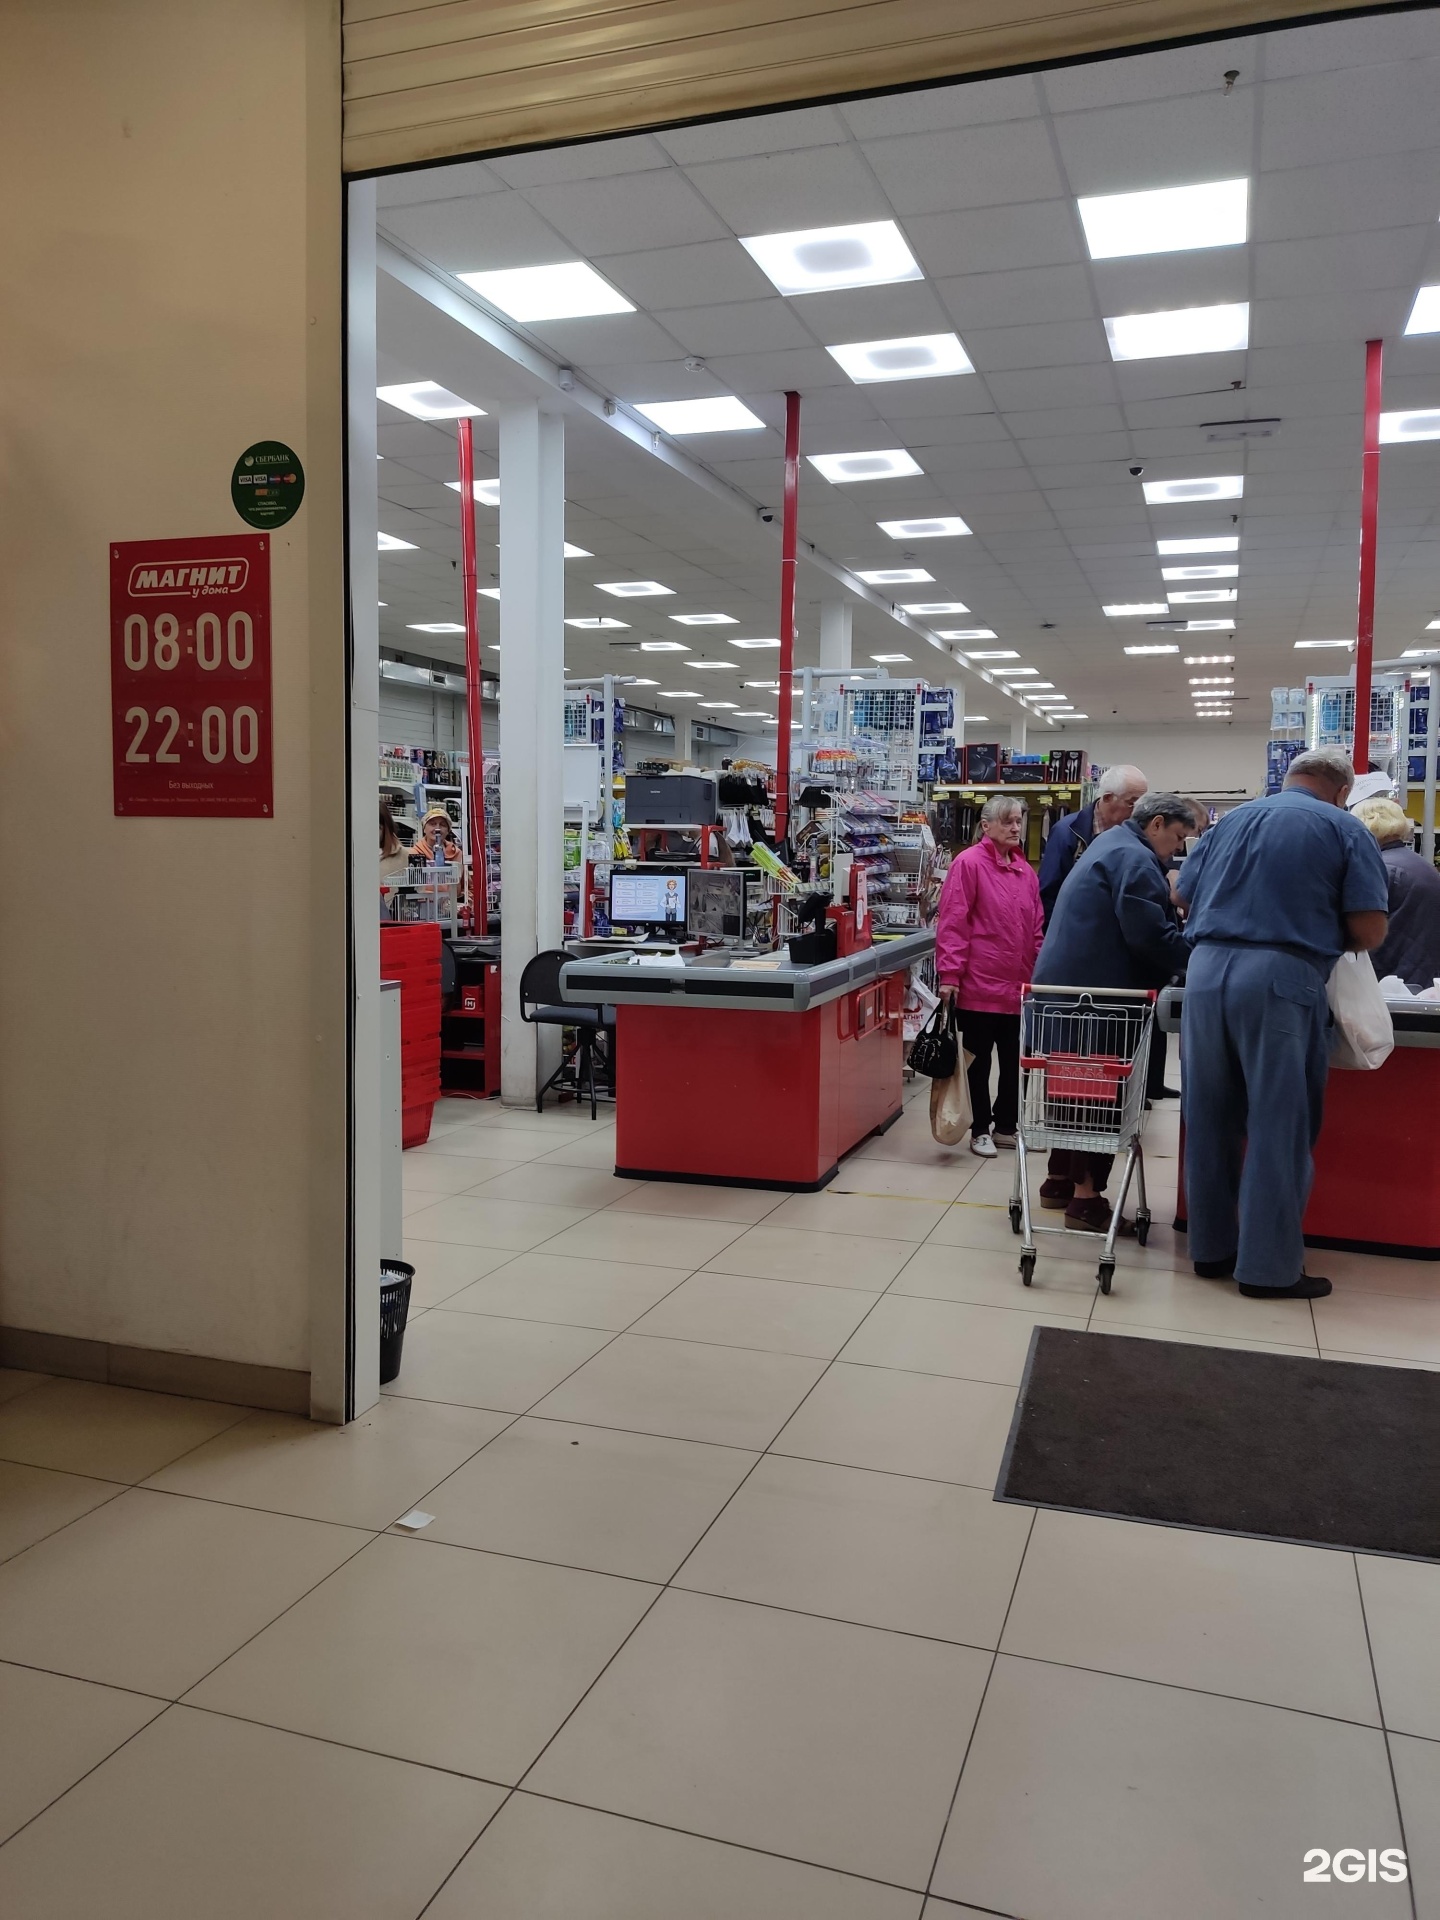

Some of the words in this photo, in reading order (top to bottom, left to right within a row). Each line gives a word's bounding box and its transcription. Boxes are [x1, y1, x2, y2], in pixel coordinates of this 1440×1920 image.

[255, 454, 290, 463] СБЕРБАНК
[135, 565, 242, 589] МАГНИТ
[191, 588, 200, 599] у
[201, 585, 229, 595] дома
[123, 610, 254, 672] 08:00
[124, 705, 259, 764] 22:00
[168, 780, 181, 789] Без
[181, 781, 214, 790] выходных
